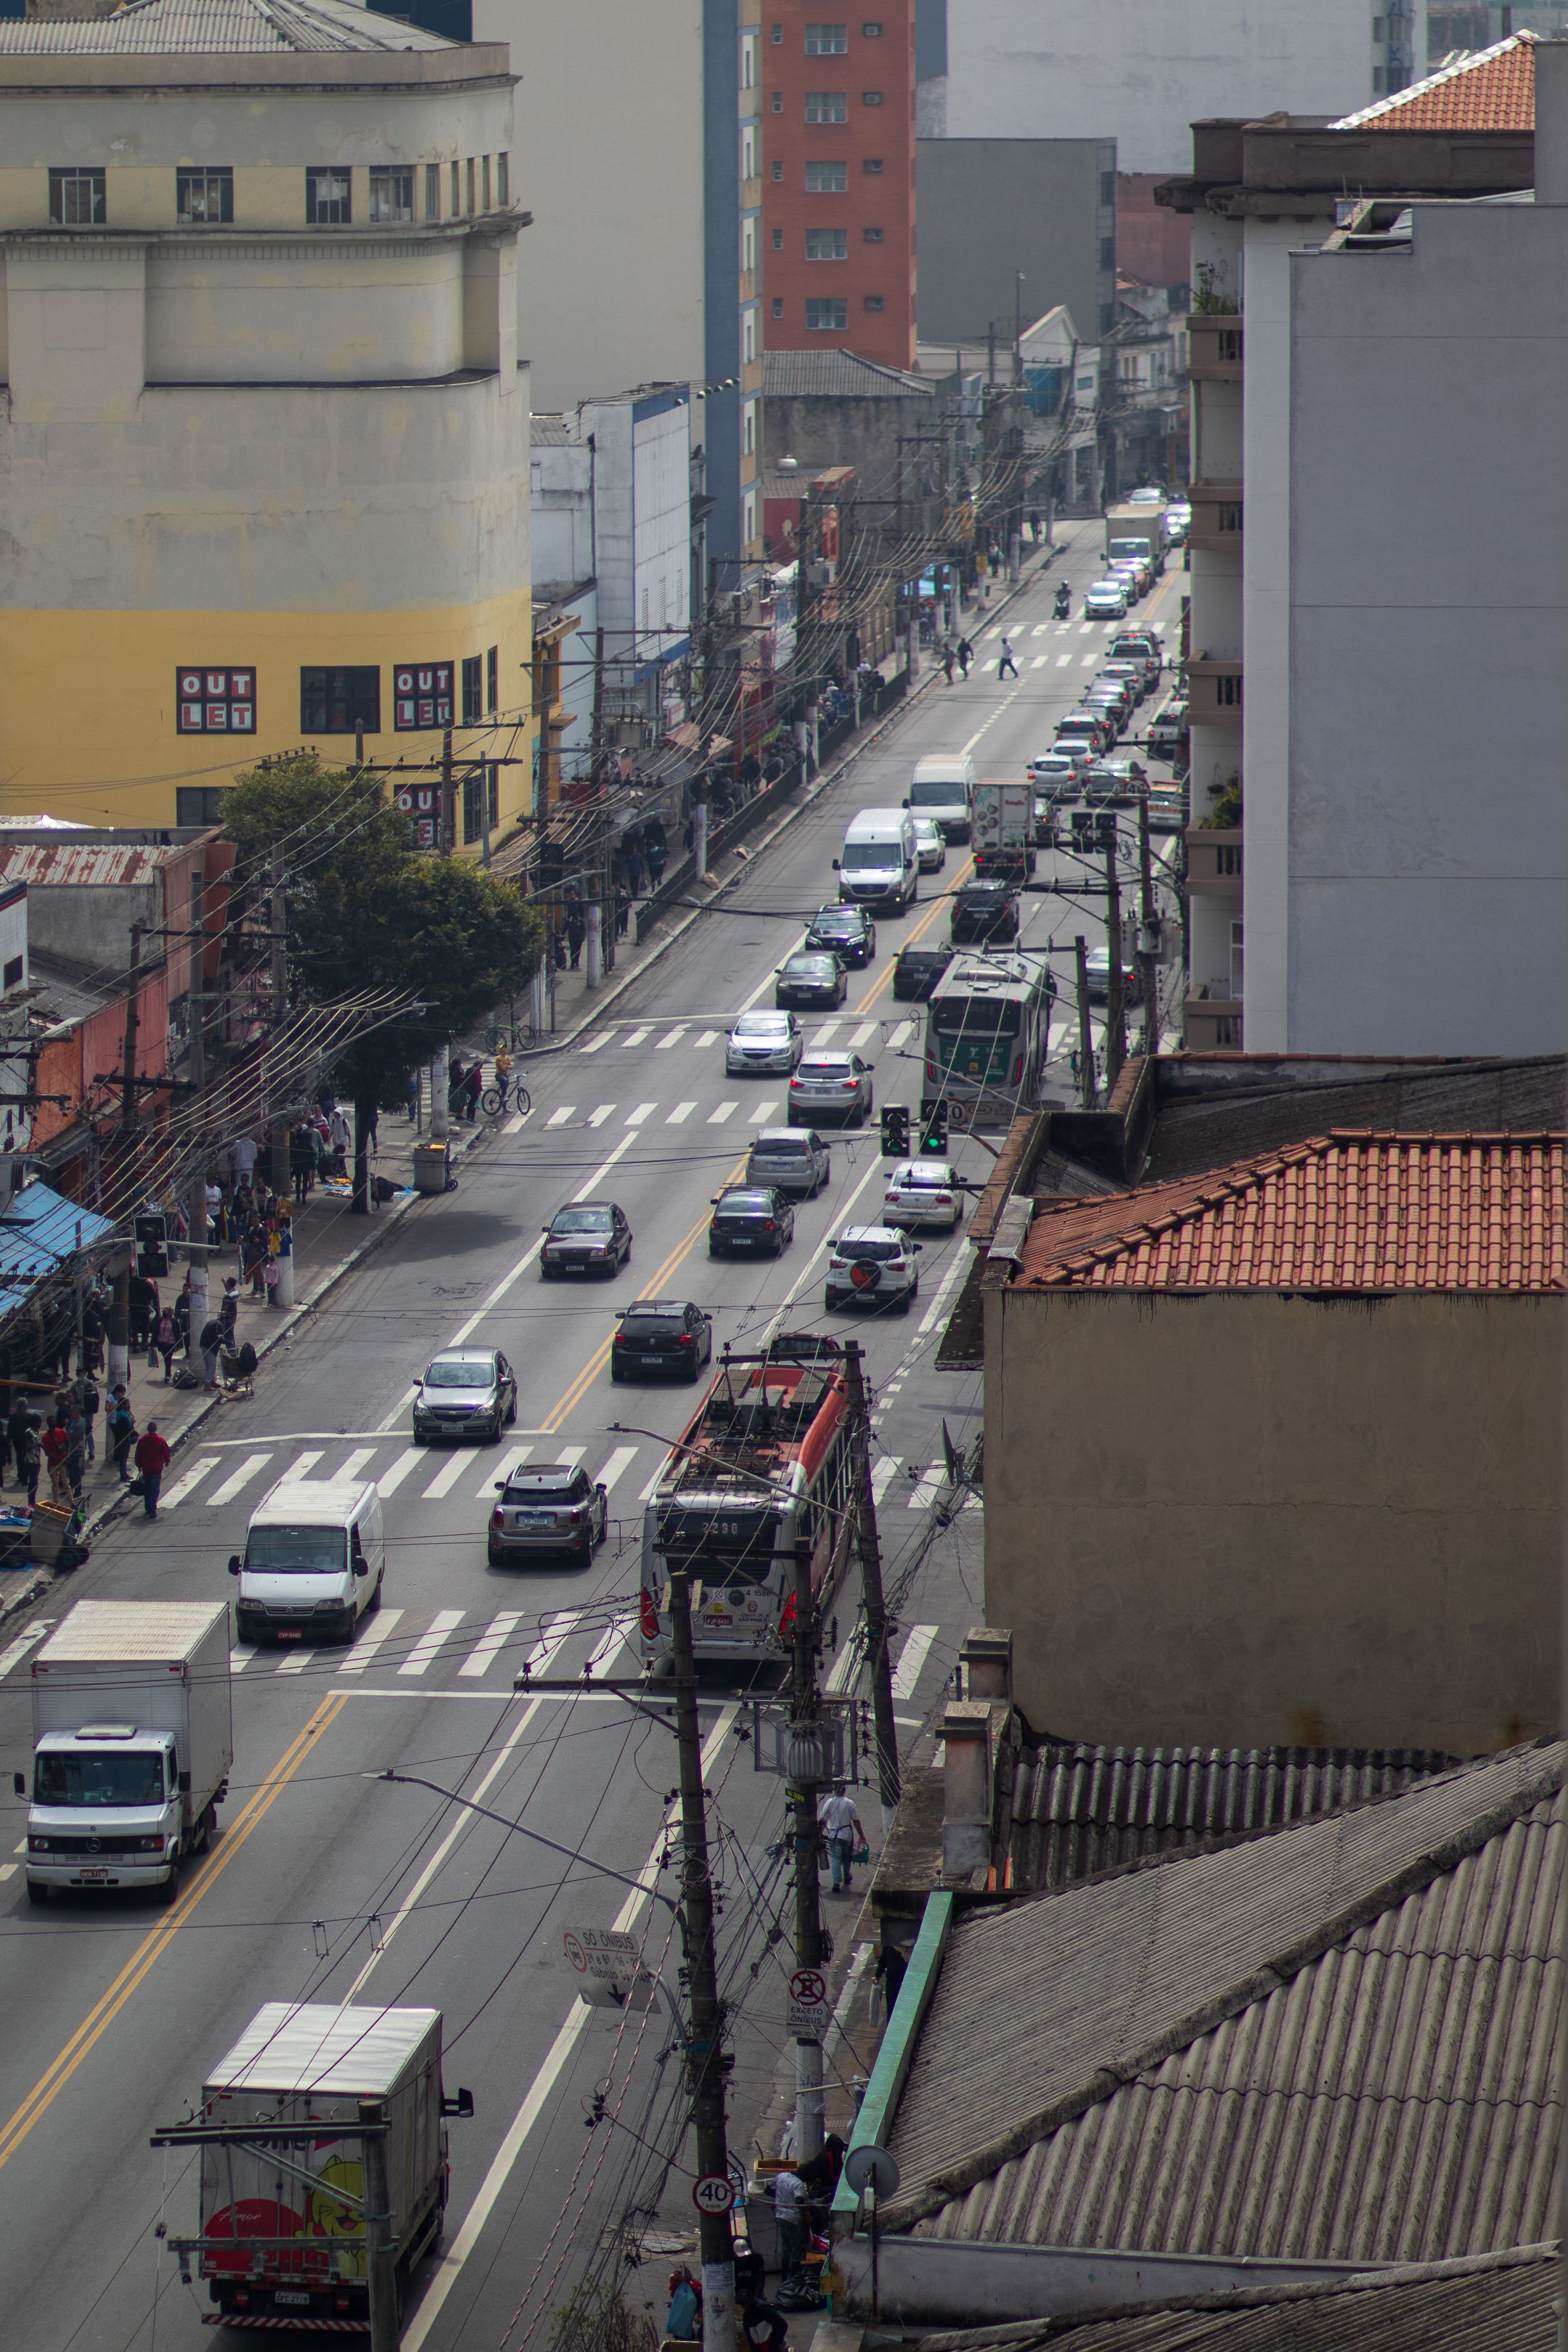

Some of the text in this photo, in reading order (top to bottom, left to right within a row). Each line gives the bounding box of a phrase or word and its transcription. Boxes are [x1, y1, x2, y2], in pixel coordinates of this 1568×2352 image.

[183, 676, 250, 693] OUT
[398, 670, 448, 690] OUT
[184, 706, 250, 726] LET
[399, 702, 448, 724] LET
[703, 1522, 738, 1534] 2290
[583, 1929, 634, 1950] SÓ ÔNIBUS
[791, 2006, 822, 2015] EXCETO
[700, 2183, 727, 2201] 40
